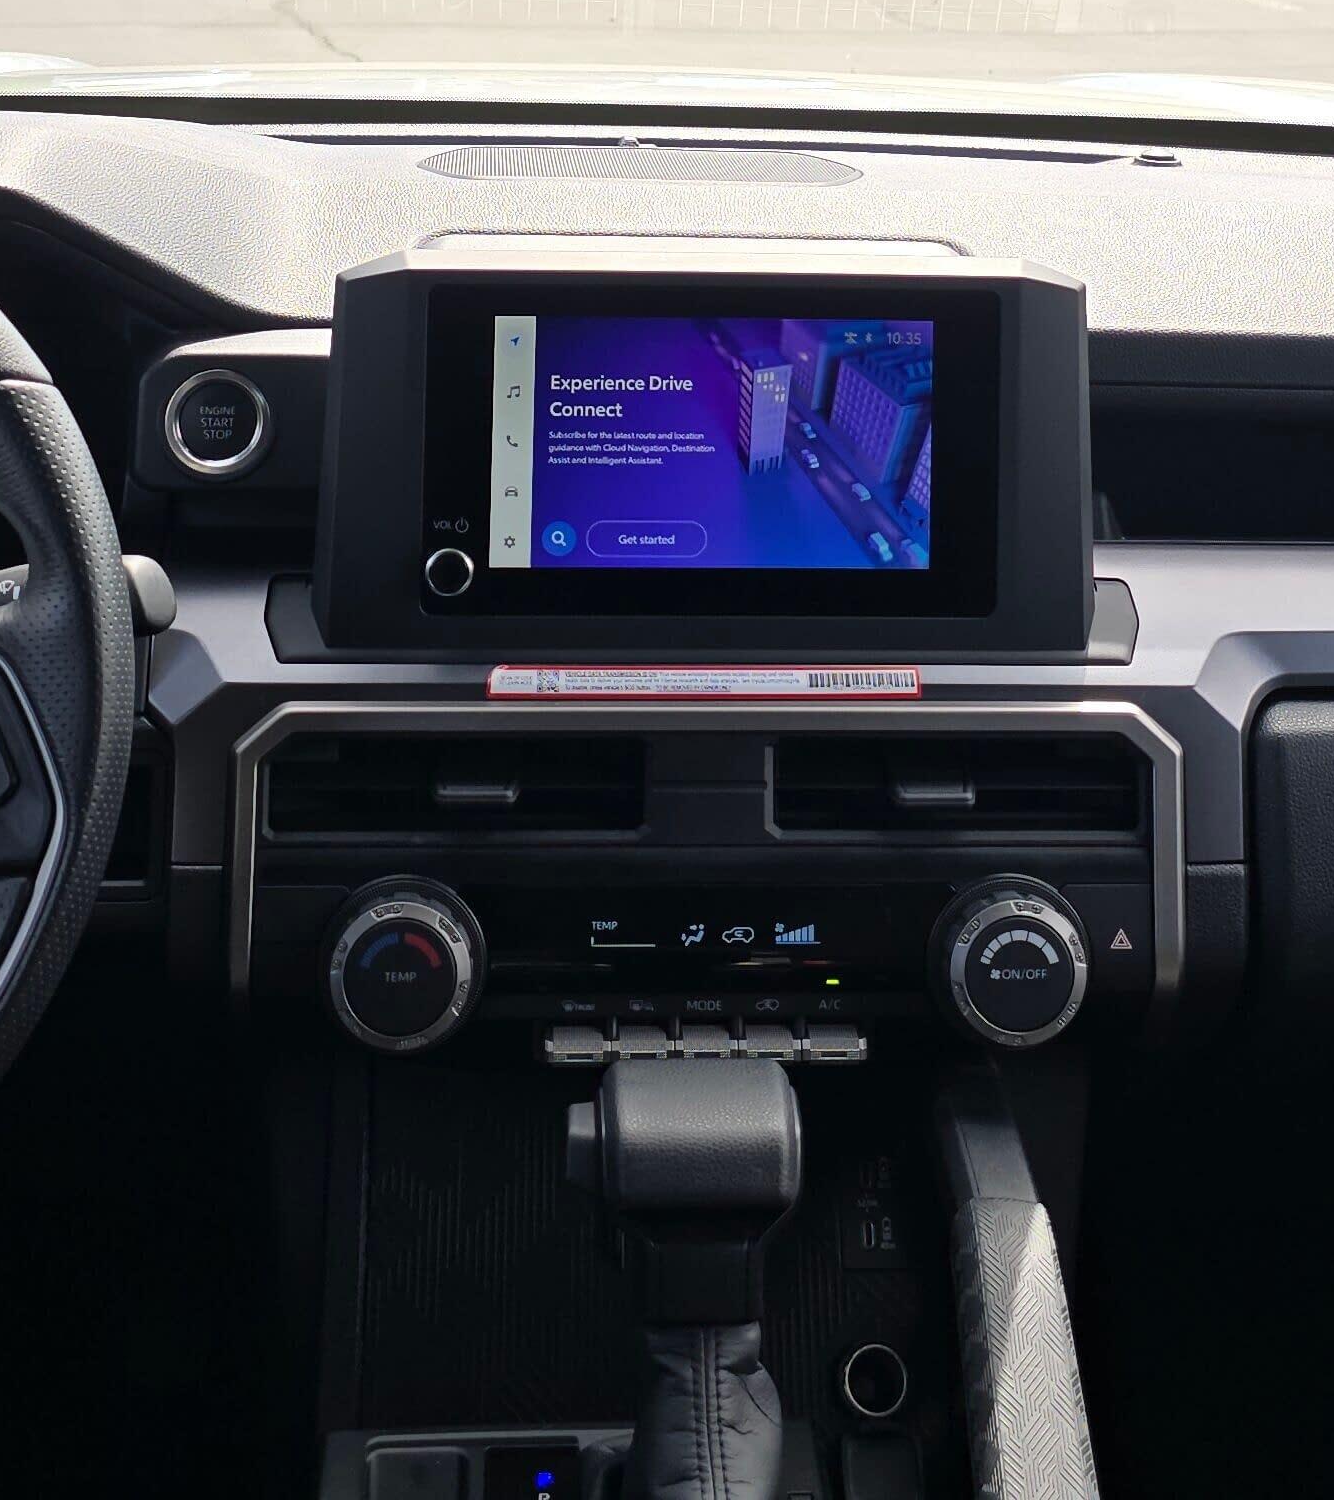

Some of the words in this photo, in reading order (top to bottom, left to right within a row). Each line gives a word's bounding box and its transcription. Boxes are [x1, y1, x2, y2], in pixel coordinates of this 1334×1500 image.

[887, 332, 922, 345] 10:35
[550, 375, 645, 393] Experience
[649, 375, 693, 391] Drive
[199, 406, 235, 415] ENGINE
[549, 401, 623, 417] Connect
[201, 417, 234, 427] START
[203, 429, 233, 440] STOP
[548, 431, 587, 440] Subscribe
[587, 431, 598, 440] for
[599, 431, 612, 440] the
[613, 431, 635, 440] latest
[657, 432, 673, 440] and
[673, 432, 705, 440] location
[548, 444, 584, 453] guidance
[584, 444, 601, 452] with
[603, 444, 626, 452] Cloud
[627, 444, 670, 454] Navigation,
[671, 445, 716, 453] Destination
[548, 456, 570, 464] Assist
[588, 456, 627, 466] Intelligent
[628, 456, 664, 465] Assistant.
[618, 535, 637, 545] Get
[639, 535, 675, 545] started
[591, 920, 618, 931] TEMP
[384, 971, 417, 983] TEMP
[1001, 968, 1048, 981] ON/OFF
[686, 1000, 722, 1011] MODE
[818, 999, 842, 1011] A/C
